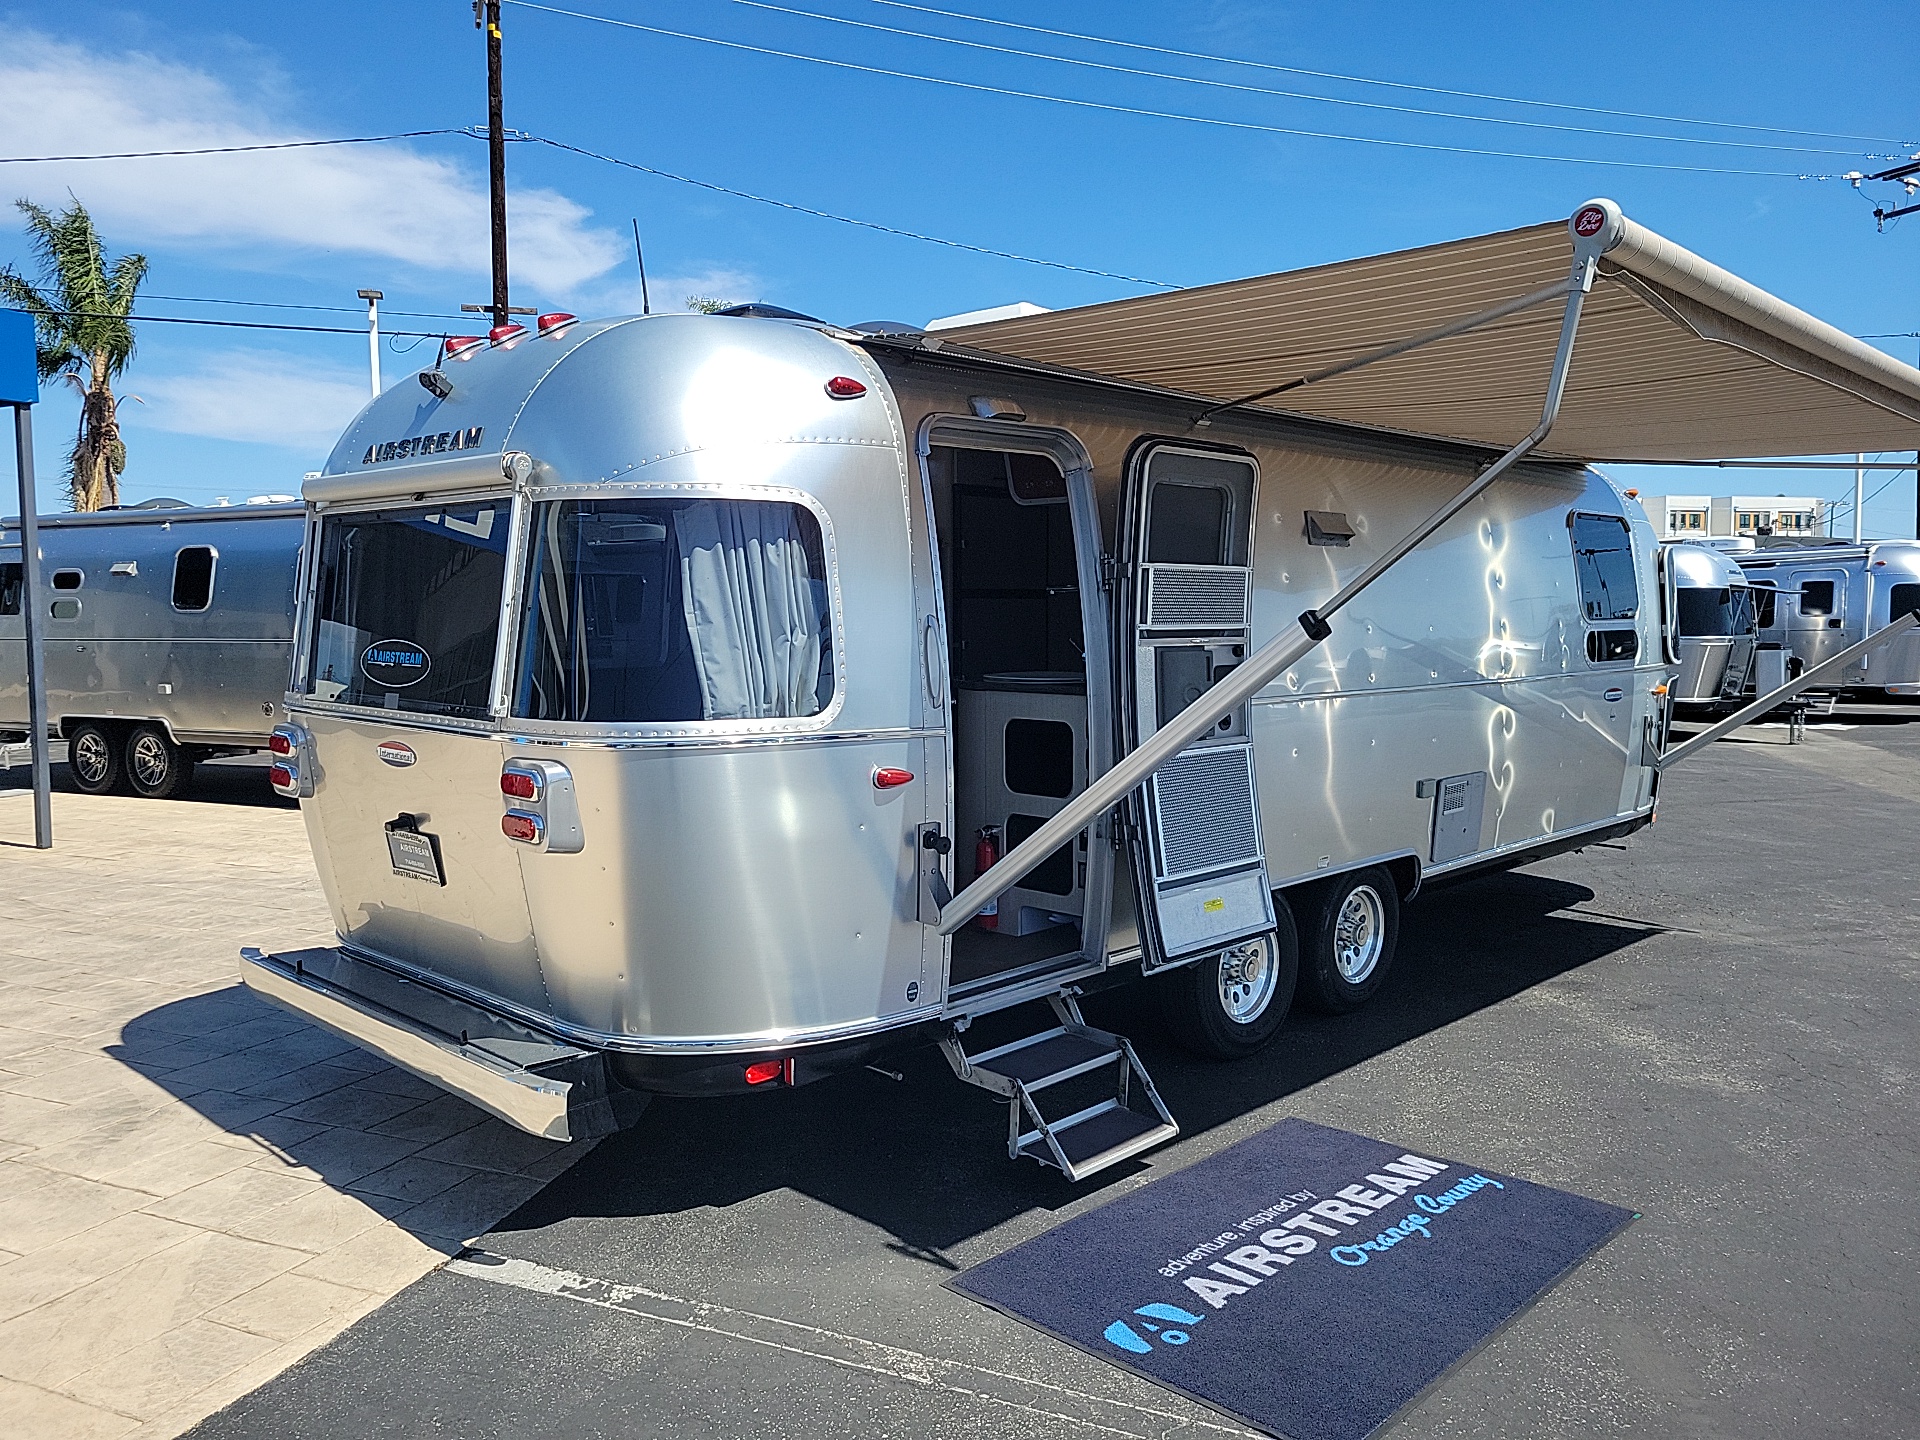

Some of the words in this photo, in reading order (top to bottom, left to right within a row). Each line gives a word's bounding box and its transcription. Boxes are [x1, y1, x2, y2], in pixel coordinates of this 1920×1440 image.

[1577, 220, 1600, 231] Dee
[1581, 211, 1603, 224] Zip
[362, 426, 485, 464] AIRSTREAM
[377, 650, 423, 665] AIRSTREAM
[379, 747, 413, 763] International
[400, 843, 430, 857] AIRSTREAM
[1232, 1198, 1298, 1232] inspired
[1284, 1189, 1318, 1203] by
[1330, 1213, 1432, 1267] Orange
[1413, 1173, 1505, 1215] County
[1182, 1154, 1450, 1309] AIRSTREAM
